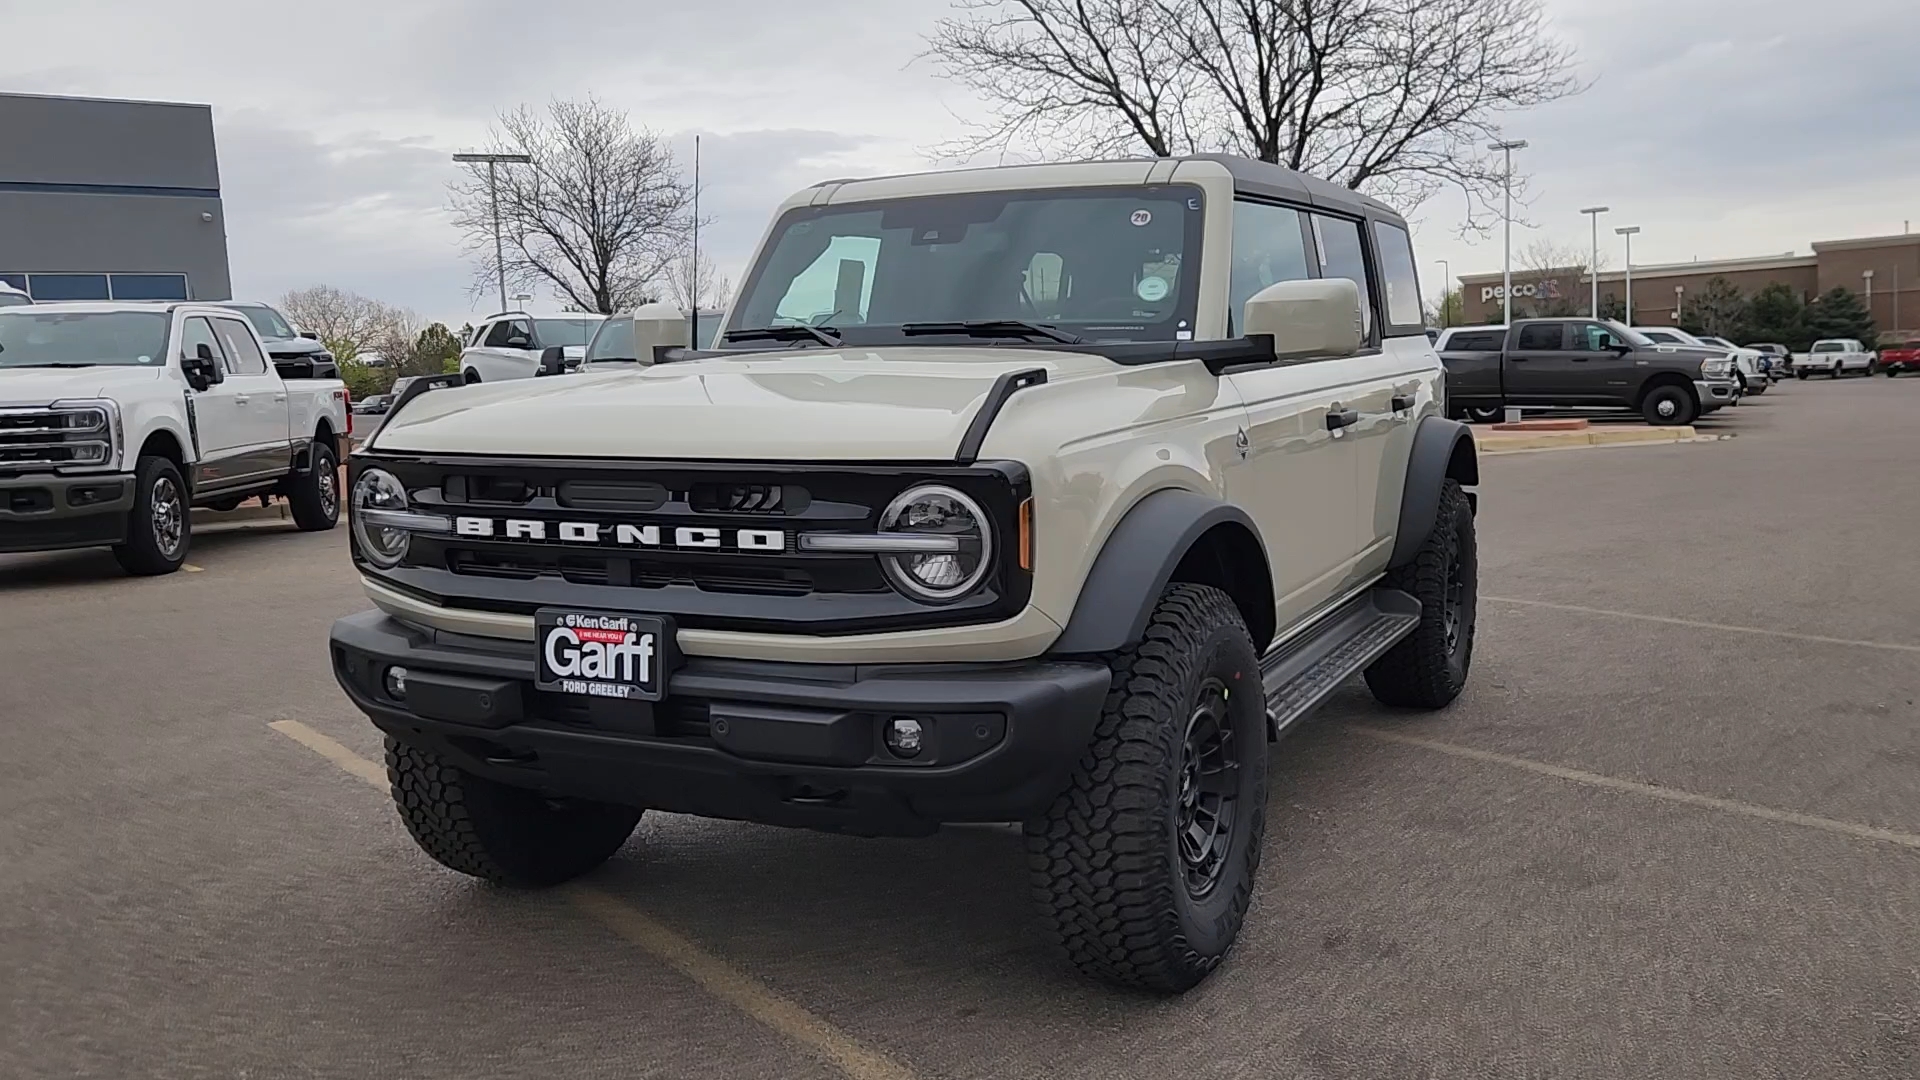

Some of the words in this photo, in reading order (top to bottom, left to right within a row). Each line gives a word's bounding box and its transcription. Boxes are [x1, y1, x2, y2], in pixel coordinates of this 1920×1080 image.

[1133, 213, 1148, 223] 20
[456, 516, 785, 550] BRONCO
[576, 615, 599, 629] Ken
[600, 616, 628, 630] Garff
[545, 627, 653, 683] Garff
[563, 681, 587, 694] FORD
[588, 684, 630, 698] GREELEY
